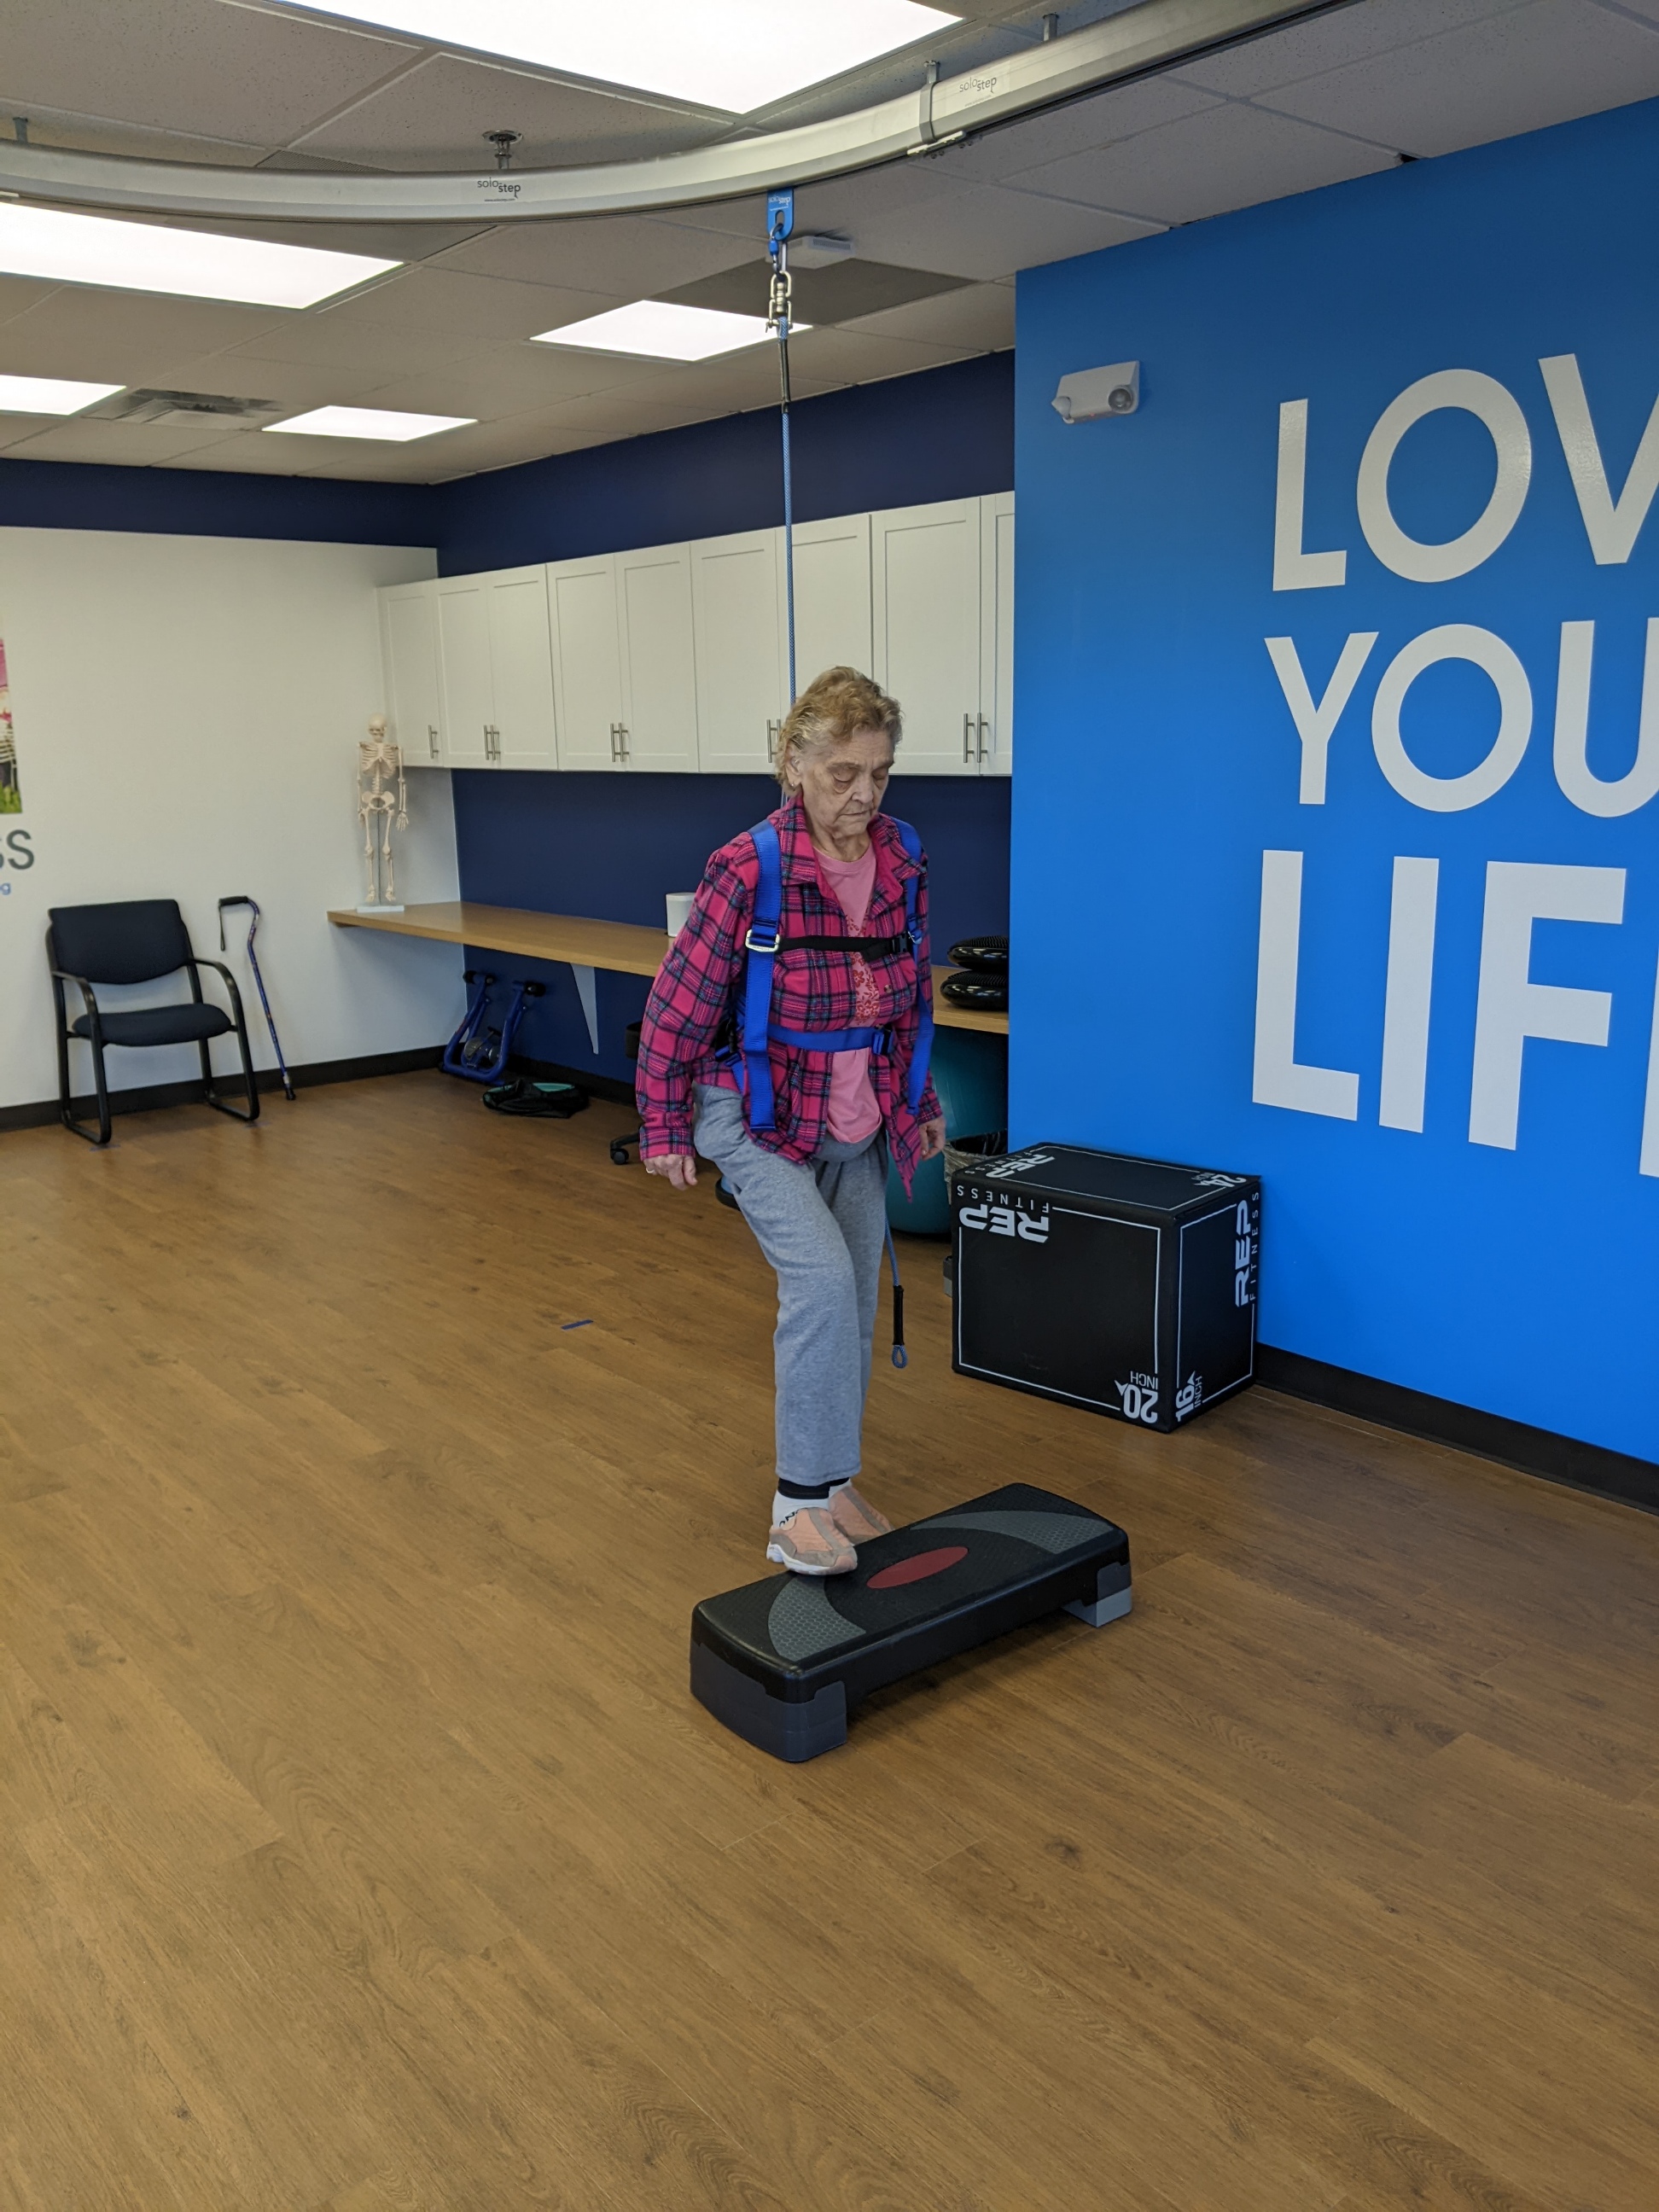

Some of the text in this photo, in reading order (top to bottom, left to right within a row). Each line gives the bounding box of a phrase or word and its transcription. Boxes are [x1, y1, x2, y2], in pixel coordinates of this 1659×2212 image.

[1272, 353, 1659, 591] LOV
[1264, 617, 1659, 818] YOU
[0, 829, 34, 870] S
[1253, 849, 1659, 1178] LIF
[985, 1154, 1055, 1179] REP
[957, 1185, 1050, 1214] FITNESS
[958, 1203, 1050, 1243] REP
[1235, 1200, 1251, 1307] REP
[1249, 1191, 1260, 1301] FITNESS
[1130, 1371, 1159, 1391] INCH
[1195, 1375, 1203, 1408] INCH
[1123, 1383, 1159, 1423] 20
[1175, 1384, 1196, 1423] 16
